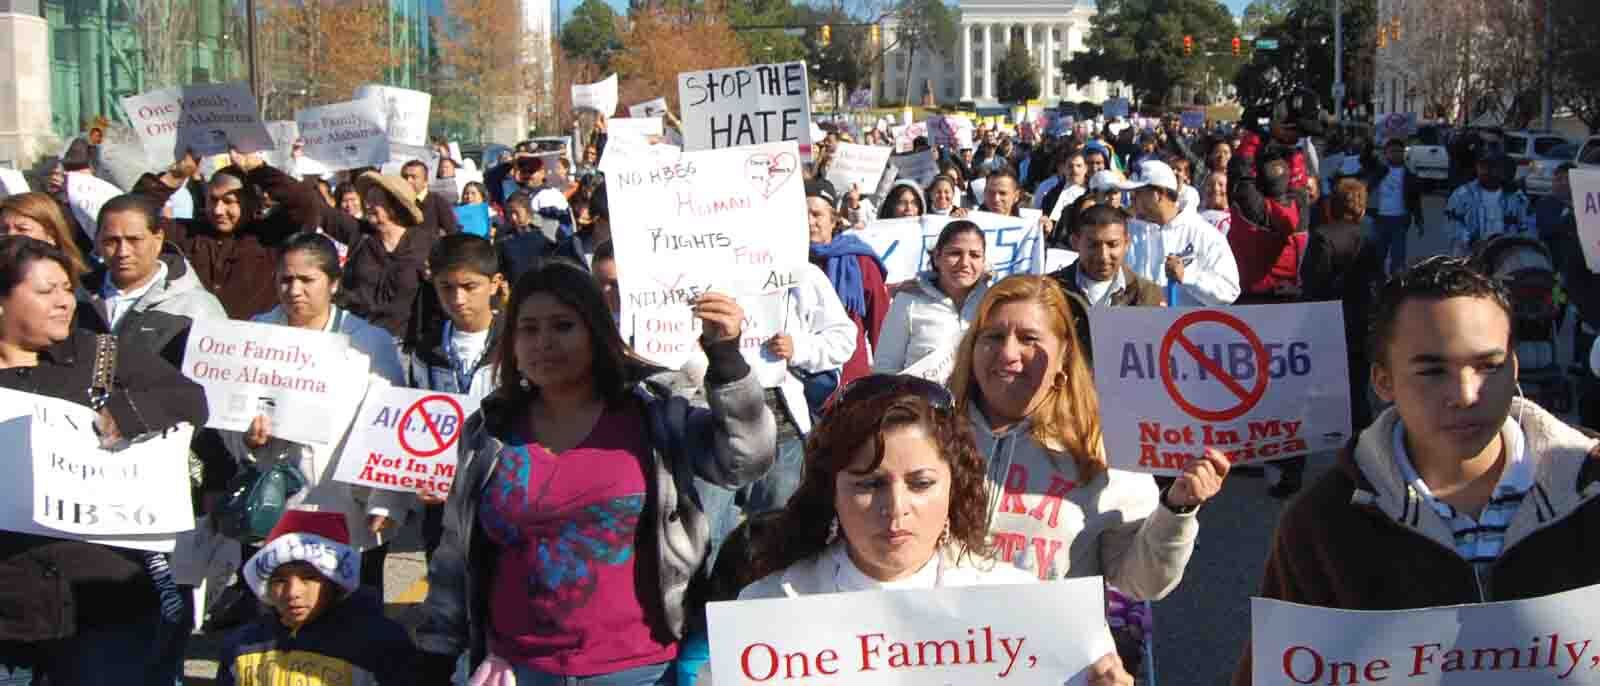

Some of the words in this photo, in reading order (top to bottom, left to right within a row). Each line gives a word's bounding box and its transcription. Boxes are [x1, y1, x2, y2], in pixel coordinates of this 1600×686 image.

[755, 63, 801, 97] THE
[138, 102, 176, 120] One
[145, 119, 185, 137] One
[709, 107, 802, 150] HATE
[618, 171, 643, 191] NO
[648, 227, 732, 253] RIGHTS
[762, 269, 800, 289] ALL
[645, 319, 685, 332] One
[198, 335, 238, 355] One
[242, 340, 317, 370] Family,
[645, 338, 685, 352] One
[193, 360, 232, 381] One
[235, 366, 329, 393] Alabama
[1138, 421, 1194, 444] Not
[1202, 424, 1240, 446] In
[1248, 419, 1303, 439] My
[367, 452, 402, 469] Not
[405, 458, 428, 473] In
[1138, 440, 1308, 468] Amrica
[358, 465, 449, 493] Americ
[740, 642, 839, 682] One
[855, 624, 1039, 678] Family,
[1282, 645, 1391, 686] One
[1408, 632, 1600, 680] Family,
